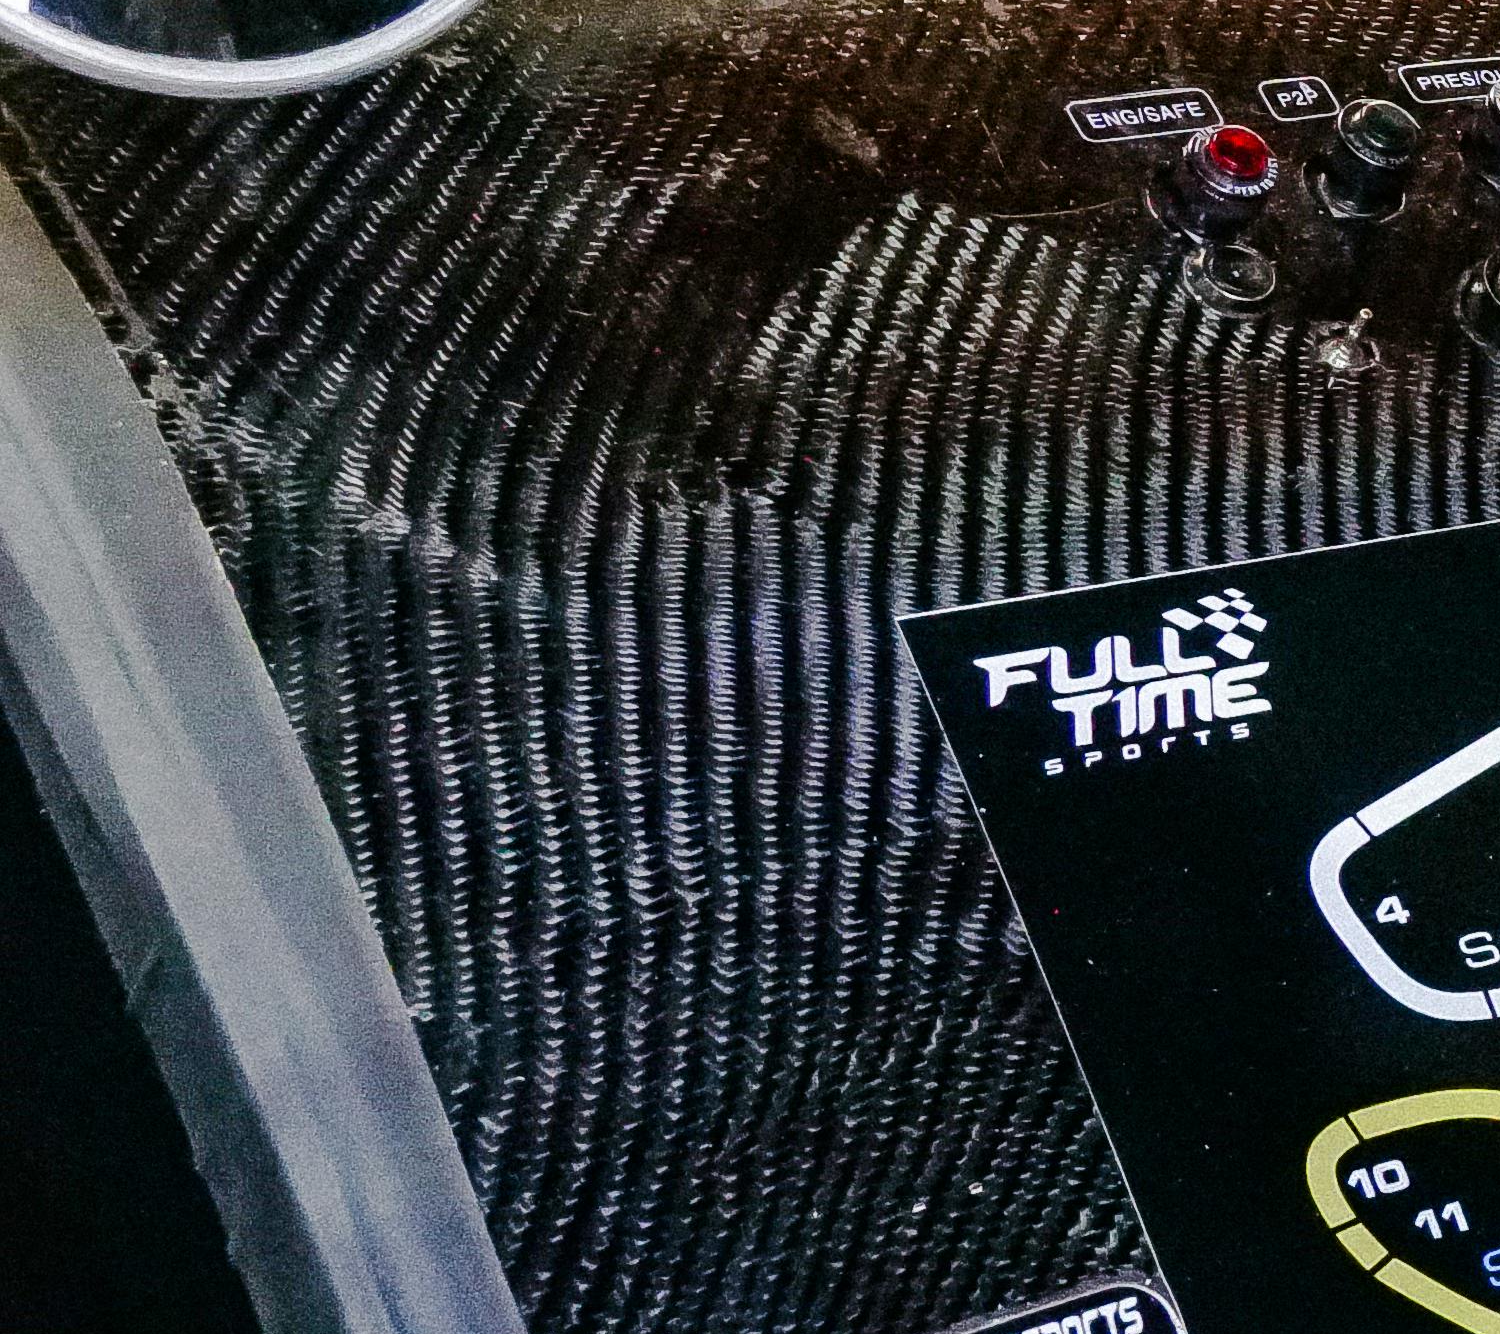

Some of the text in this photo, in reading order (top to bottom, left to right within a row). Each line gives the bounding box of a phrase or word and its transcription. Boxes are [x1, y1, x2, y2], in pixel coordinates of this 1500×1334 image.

[1277, 82, 1318, 107] P2P
[1086, 102, 1205, 128] ENG/SAFE
[973, 627, 1216, 707] FULL
[1044, 723, 1249, 775] SPORTS
[1375, 896, 1410, 924] 4
[1348, 1160, 1410, 1198] 10
[1415, 1201, 1469, 1239] 11
